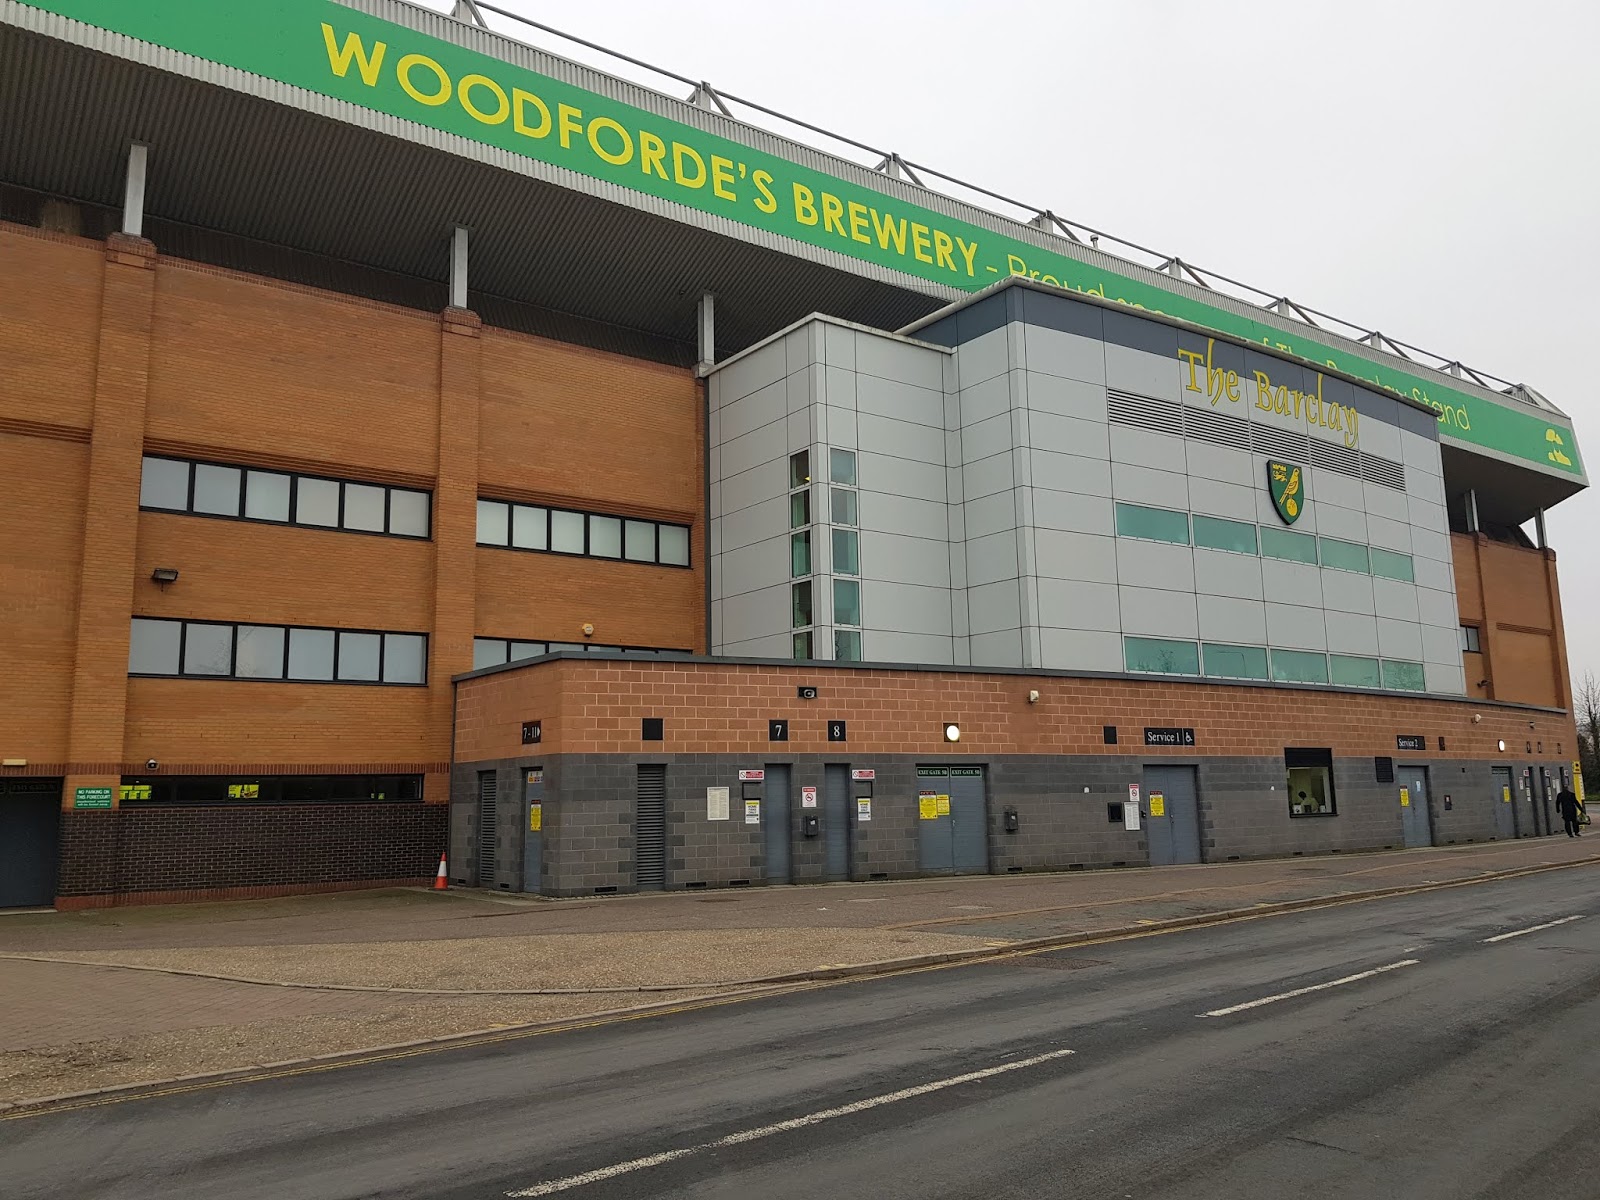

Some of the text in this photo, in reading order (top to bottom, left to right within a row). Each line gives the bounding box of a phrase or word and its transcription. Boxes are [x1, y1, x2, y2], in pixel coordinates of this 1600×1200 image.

[321, 23, 777, 213] WOODFORDE'S
[793, 184, 979, 277] BREWERY
[1178, 338, 1240, 406] The
[1253, 369, 1359, 448] Barclay
[775, 725, 782, 737] 7
[833, 725, 840, 737] 8
[1147, 731, 1180, 742] Service 1
[1398, 738, 1415, 747] Service
